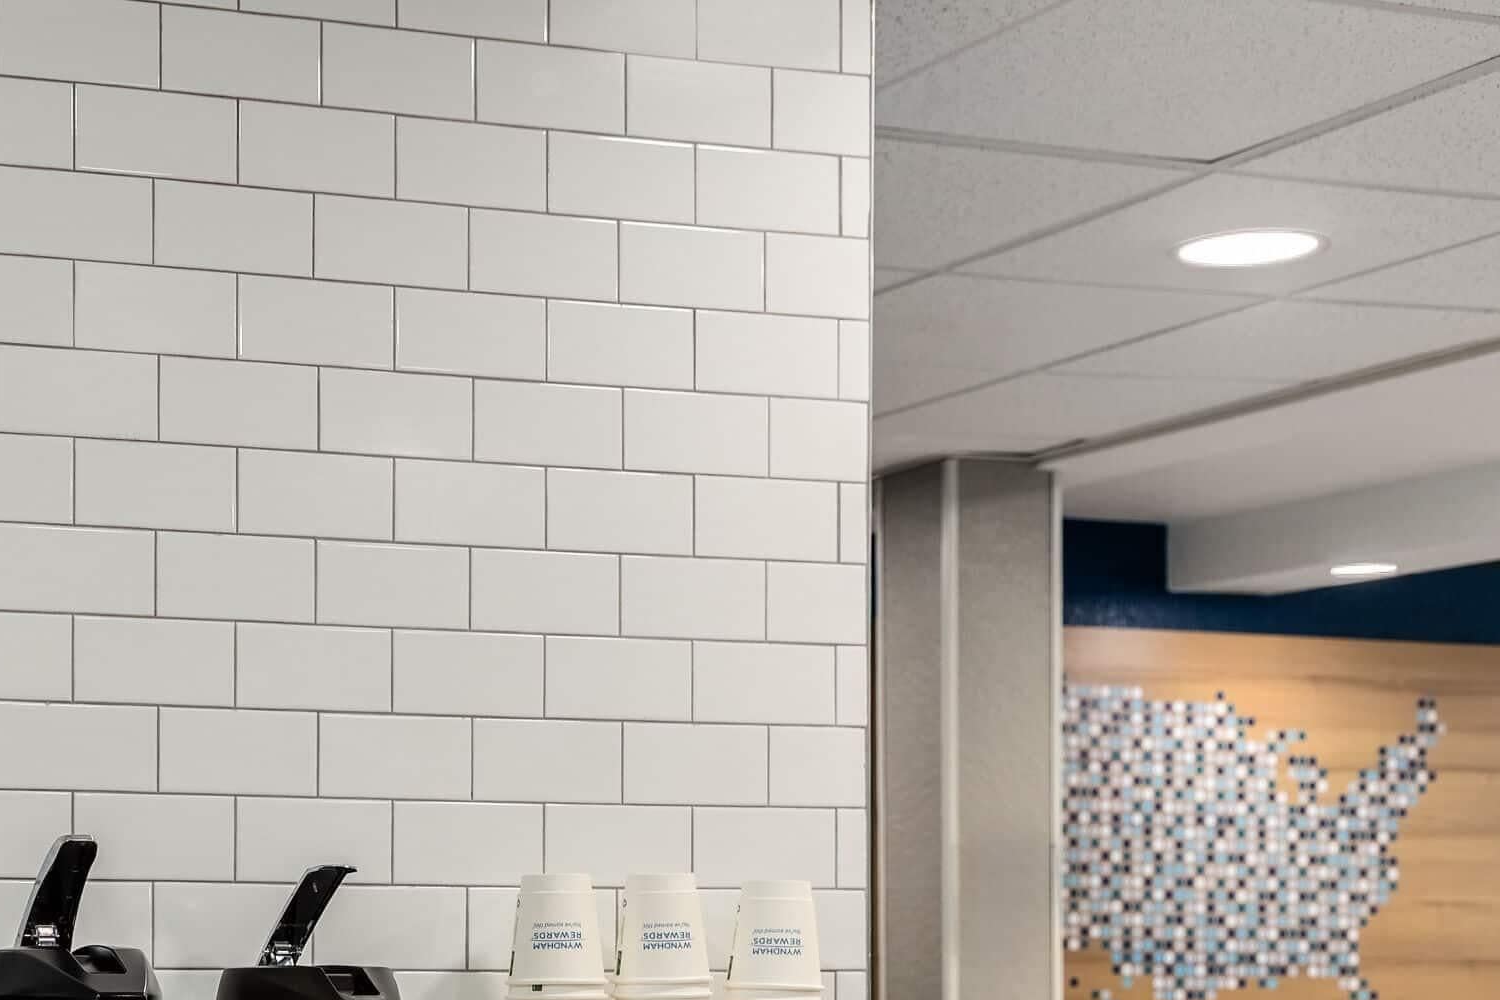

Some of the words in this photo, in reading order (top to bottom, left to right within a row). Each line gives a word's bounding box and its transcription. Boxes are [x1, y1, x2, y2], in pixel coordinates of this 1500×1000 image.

[533, 931, 582, 939] REWARDS
[643, 931, 691, 940] REWARDS
[753, 937, 801, 945] REWARDS
[533, 942, 582, 950] WYNDHAM
[643, 942, 692, 950] WYNDHAM
[752, 948, 801, 956] WYNDHAM
